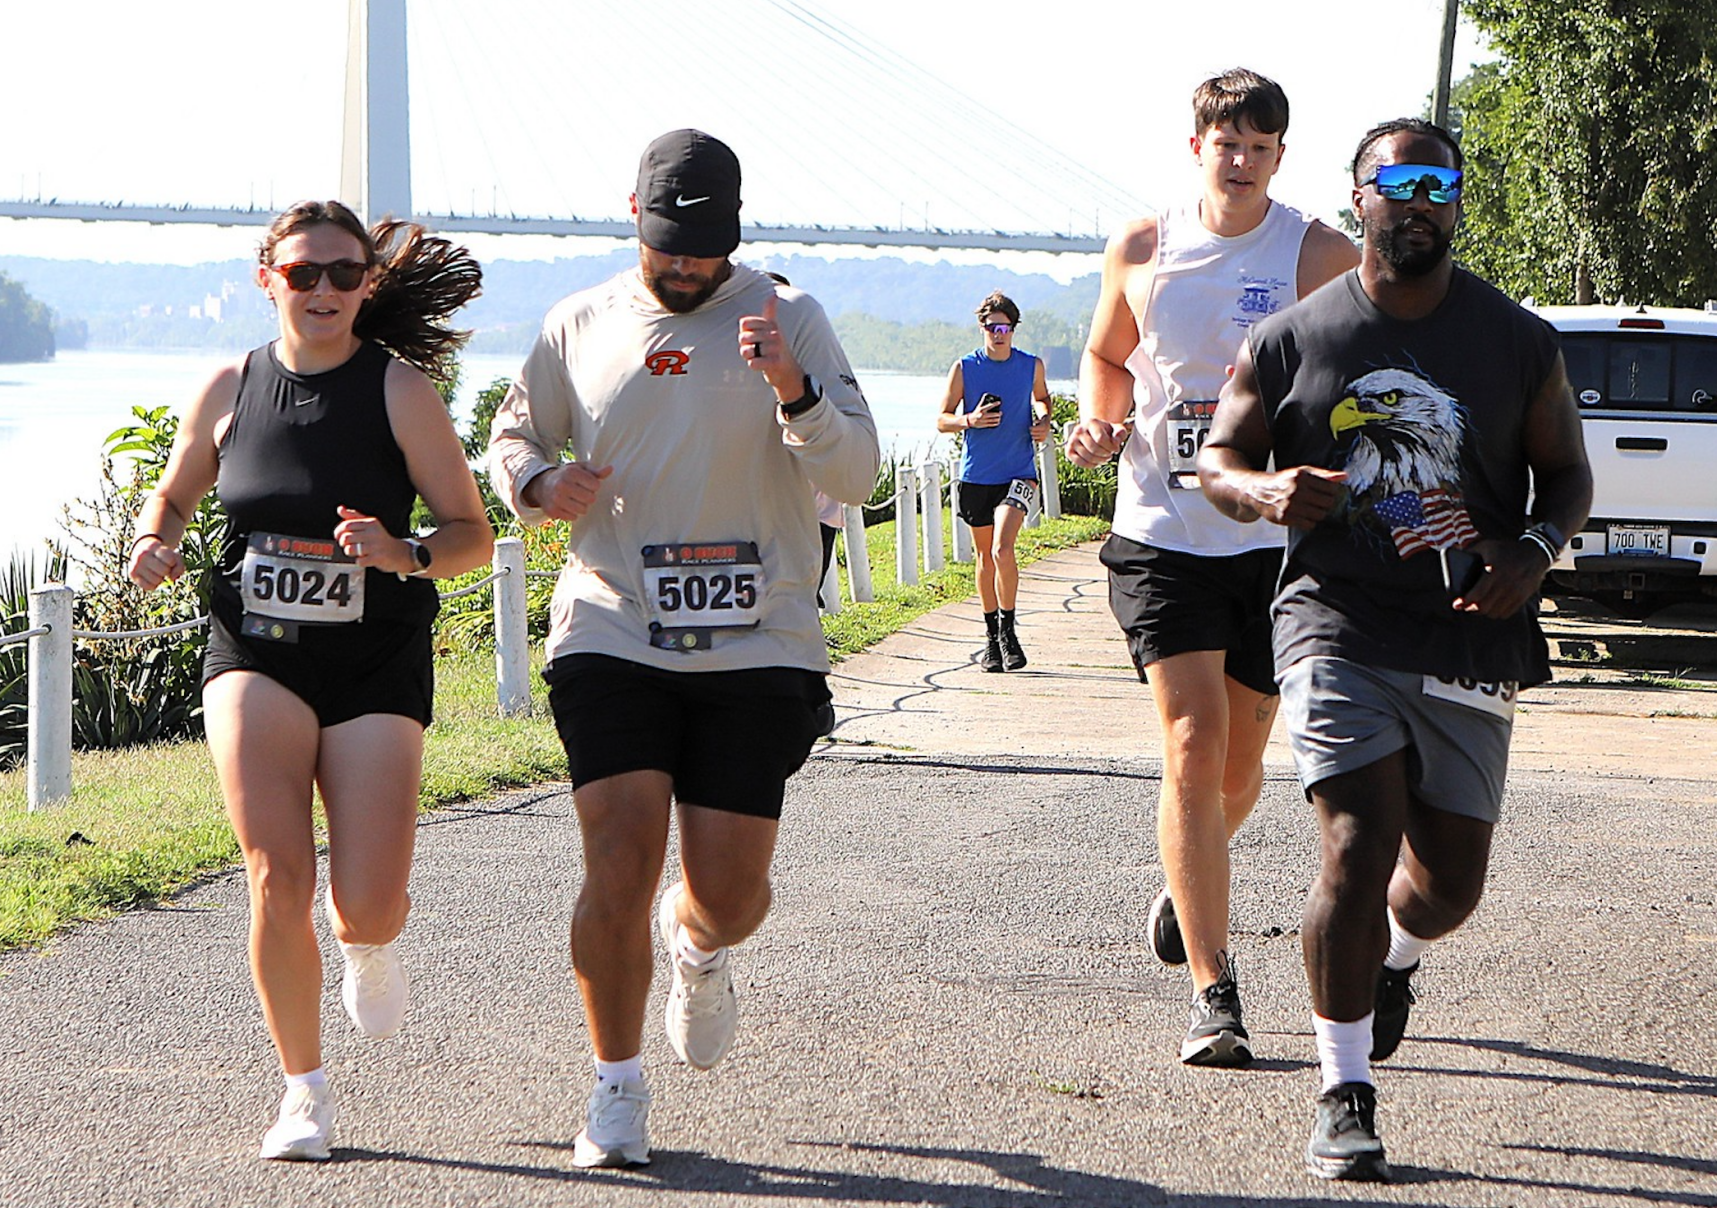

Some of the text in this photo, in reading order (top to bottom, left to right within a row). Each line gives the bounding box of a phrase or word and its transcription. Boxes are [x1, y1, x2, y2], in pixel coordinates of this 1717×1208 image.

[1614, 533, 1635, 548] 700
[253, 564, 351, 607] 5024
[658, 574, 756, 612] 5025
